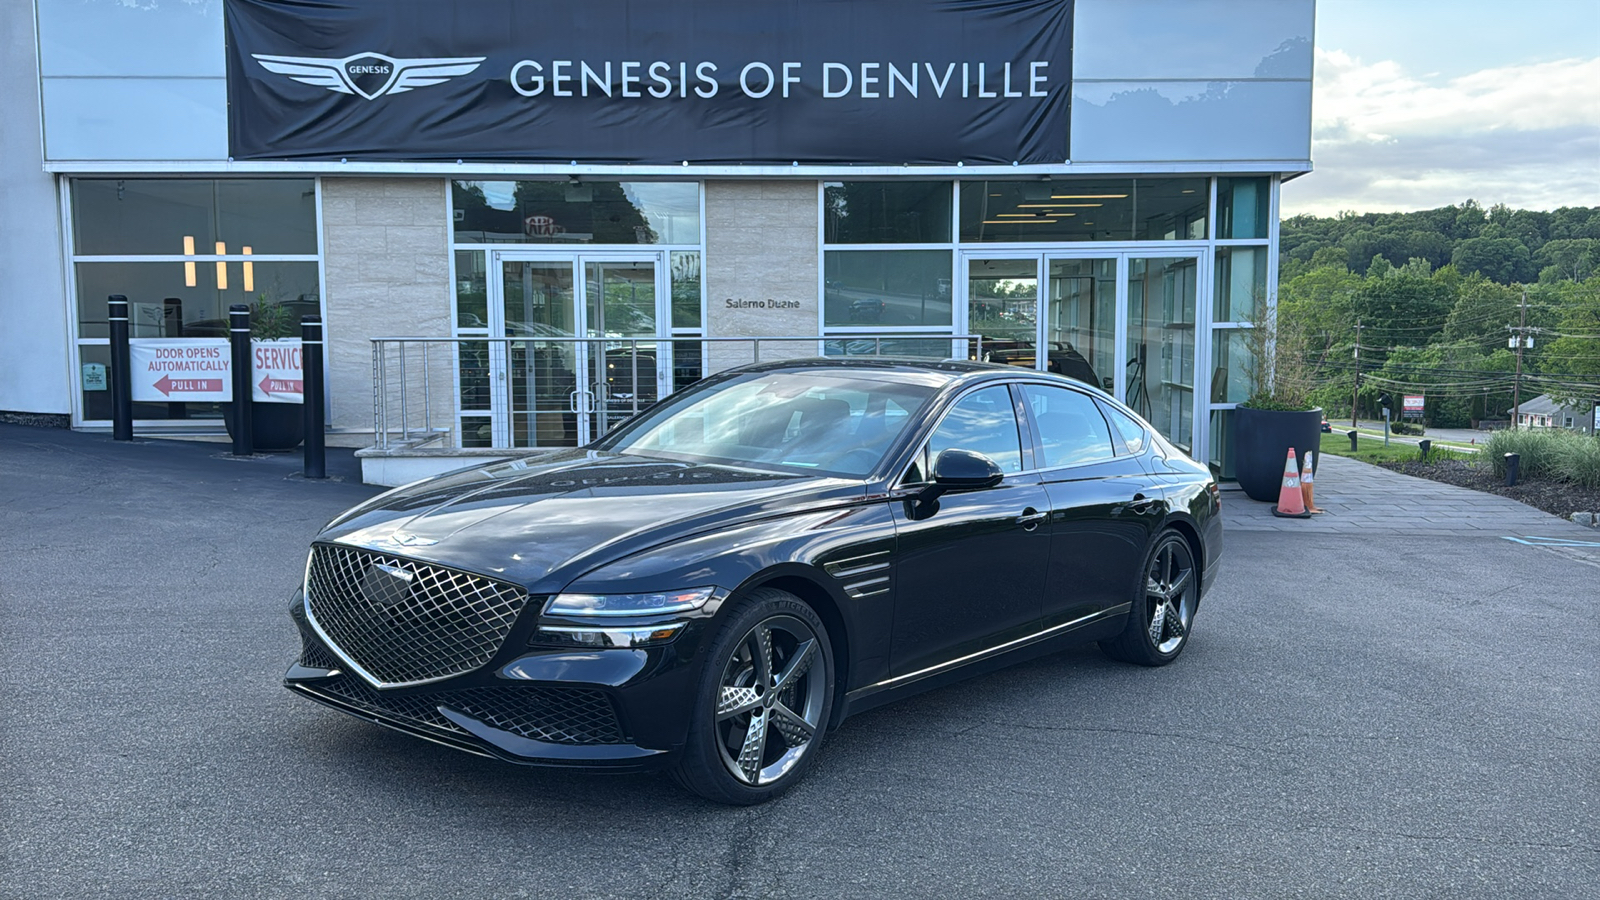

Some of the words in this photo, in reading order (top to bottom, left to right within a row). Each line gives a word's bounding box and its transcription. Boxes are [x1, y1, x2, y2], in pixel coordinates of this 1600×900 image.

[349, 65, 390, 74] GENESIS
[510, 59, 719, 99] GENESIS
[740, 61, 801, 99] OF
[823, 61, 1049, 99] DENVILLE
[725, 298, 765, 309] Salerno
[767, 298, 801, 309] Duane
[156, 348, 184, 359] DOOR
[186, 347, 220, 359] OPENS
[148, 360, 229, 372] AUTOMATICALLY
[171, 381, 194, 390] PULL
[197, 381, 208, 390] IN
[270, 381, 286, 391] PULL
[287, 381, 294, 391] IN
[778, 600, 821, 628] MICHELIN
